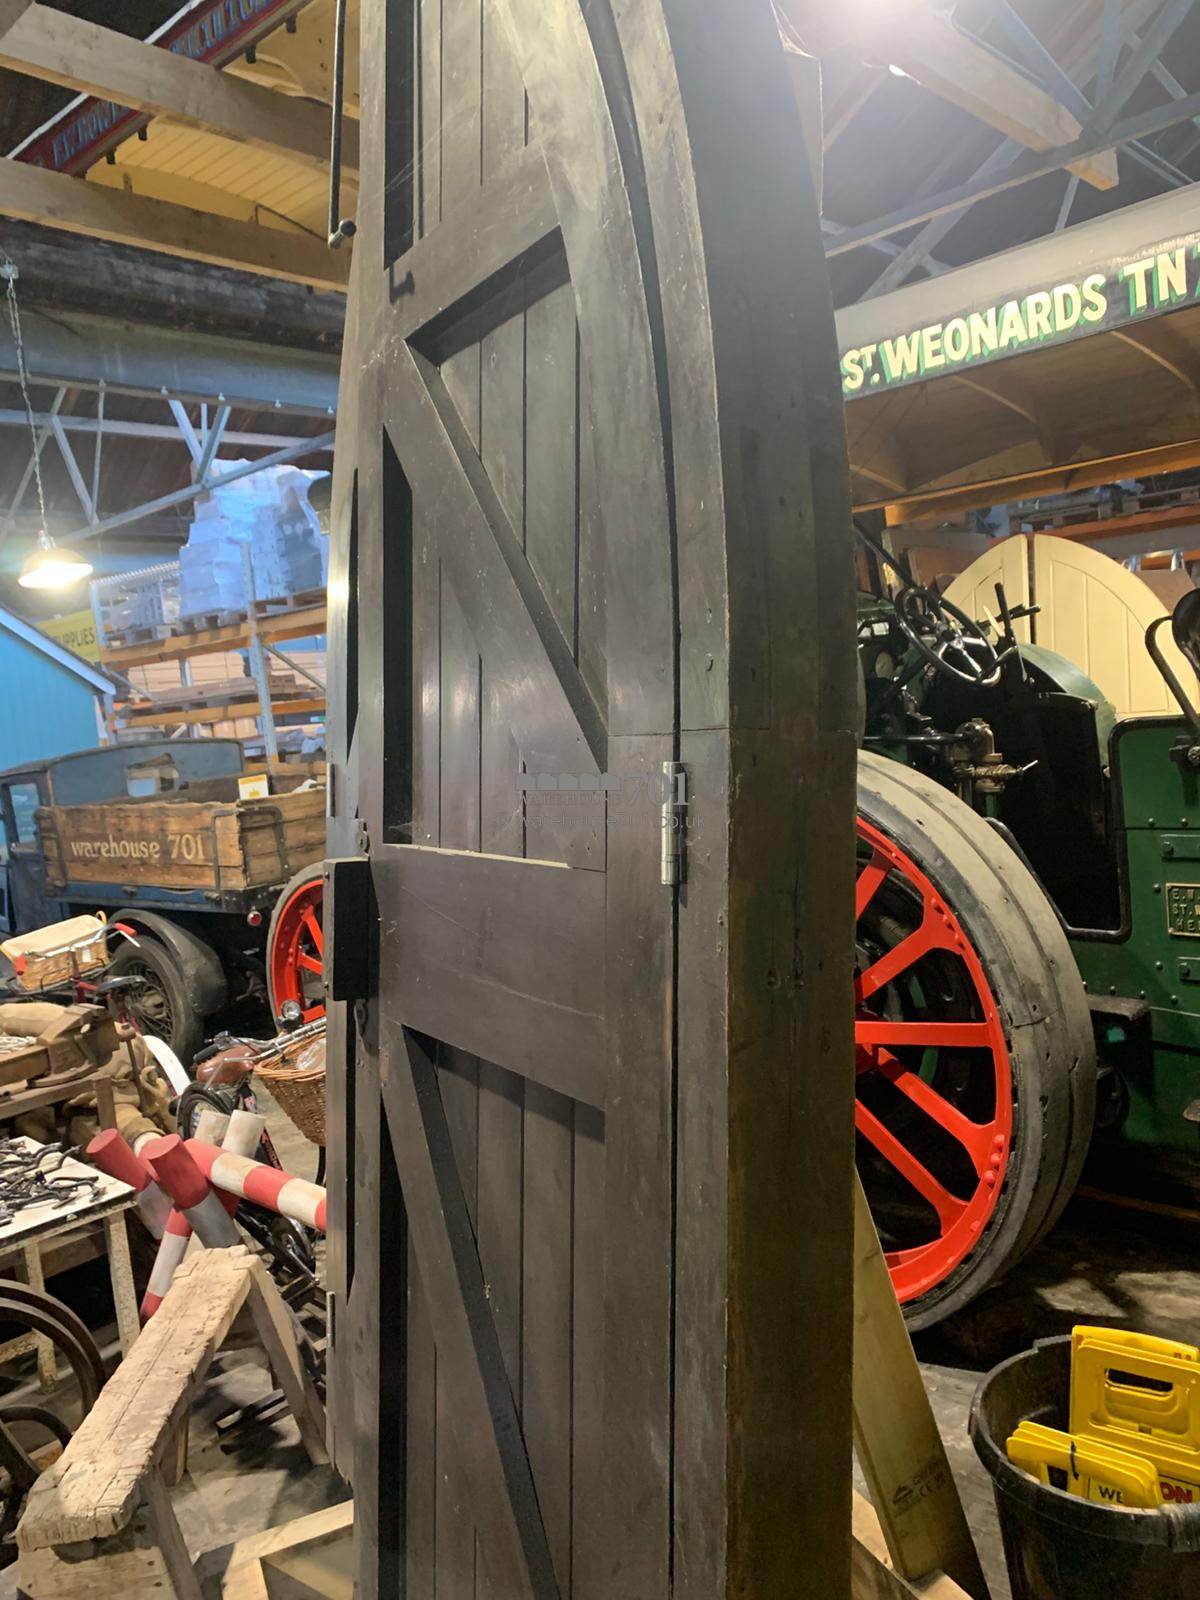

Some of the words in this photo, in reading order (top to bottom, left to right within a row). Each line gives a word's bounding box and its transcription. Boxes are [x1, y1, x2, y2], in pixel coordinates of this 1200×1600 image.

[879, 273, 1107, 385] WEONARDS
[71, 834, 161, 858] warehouse
[168, 833, 205, 860] 701
